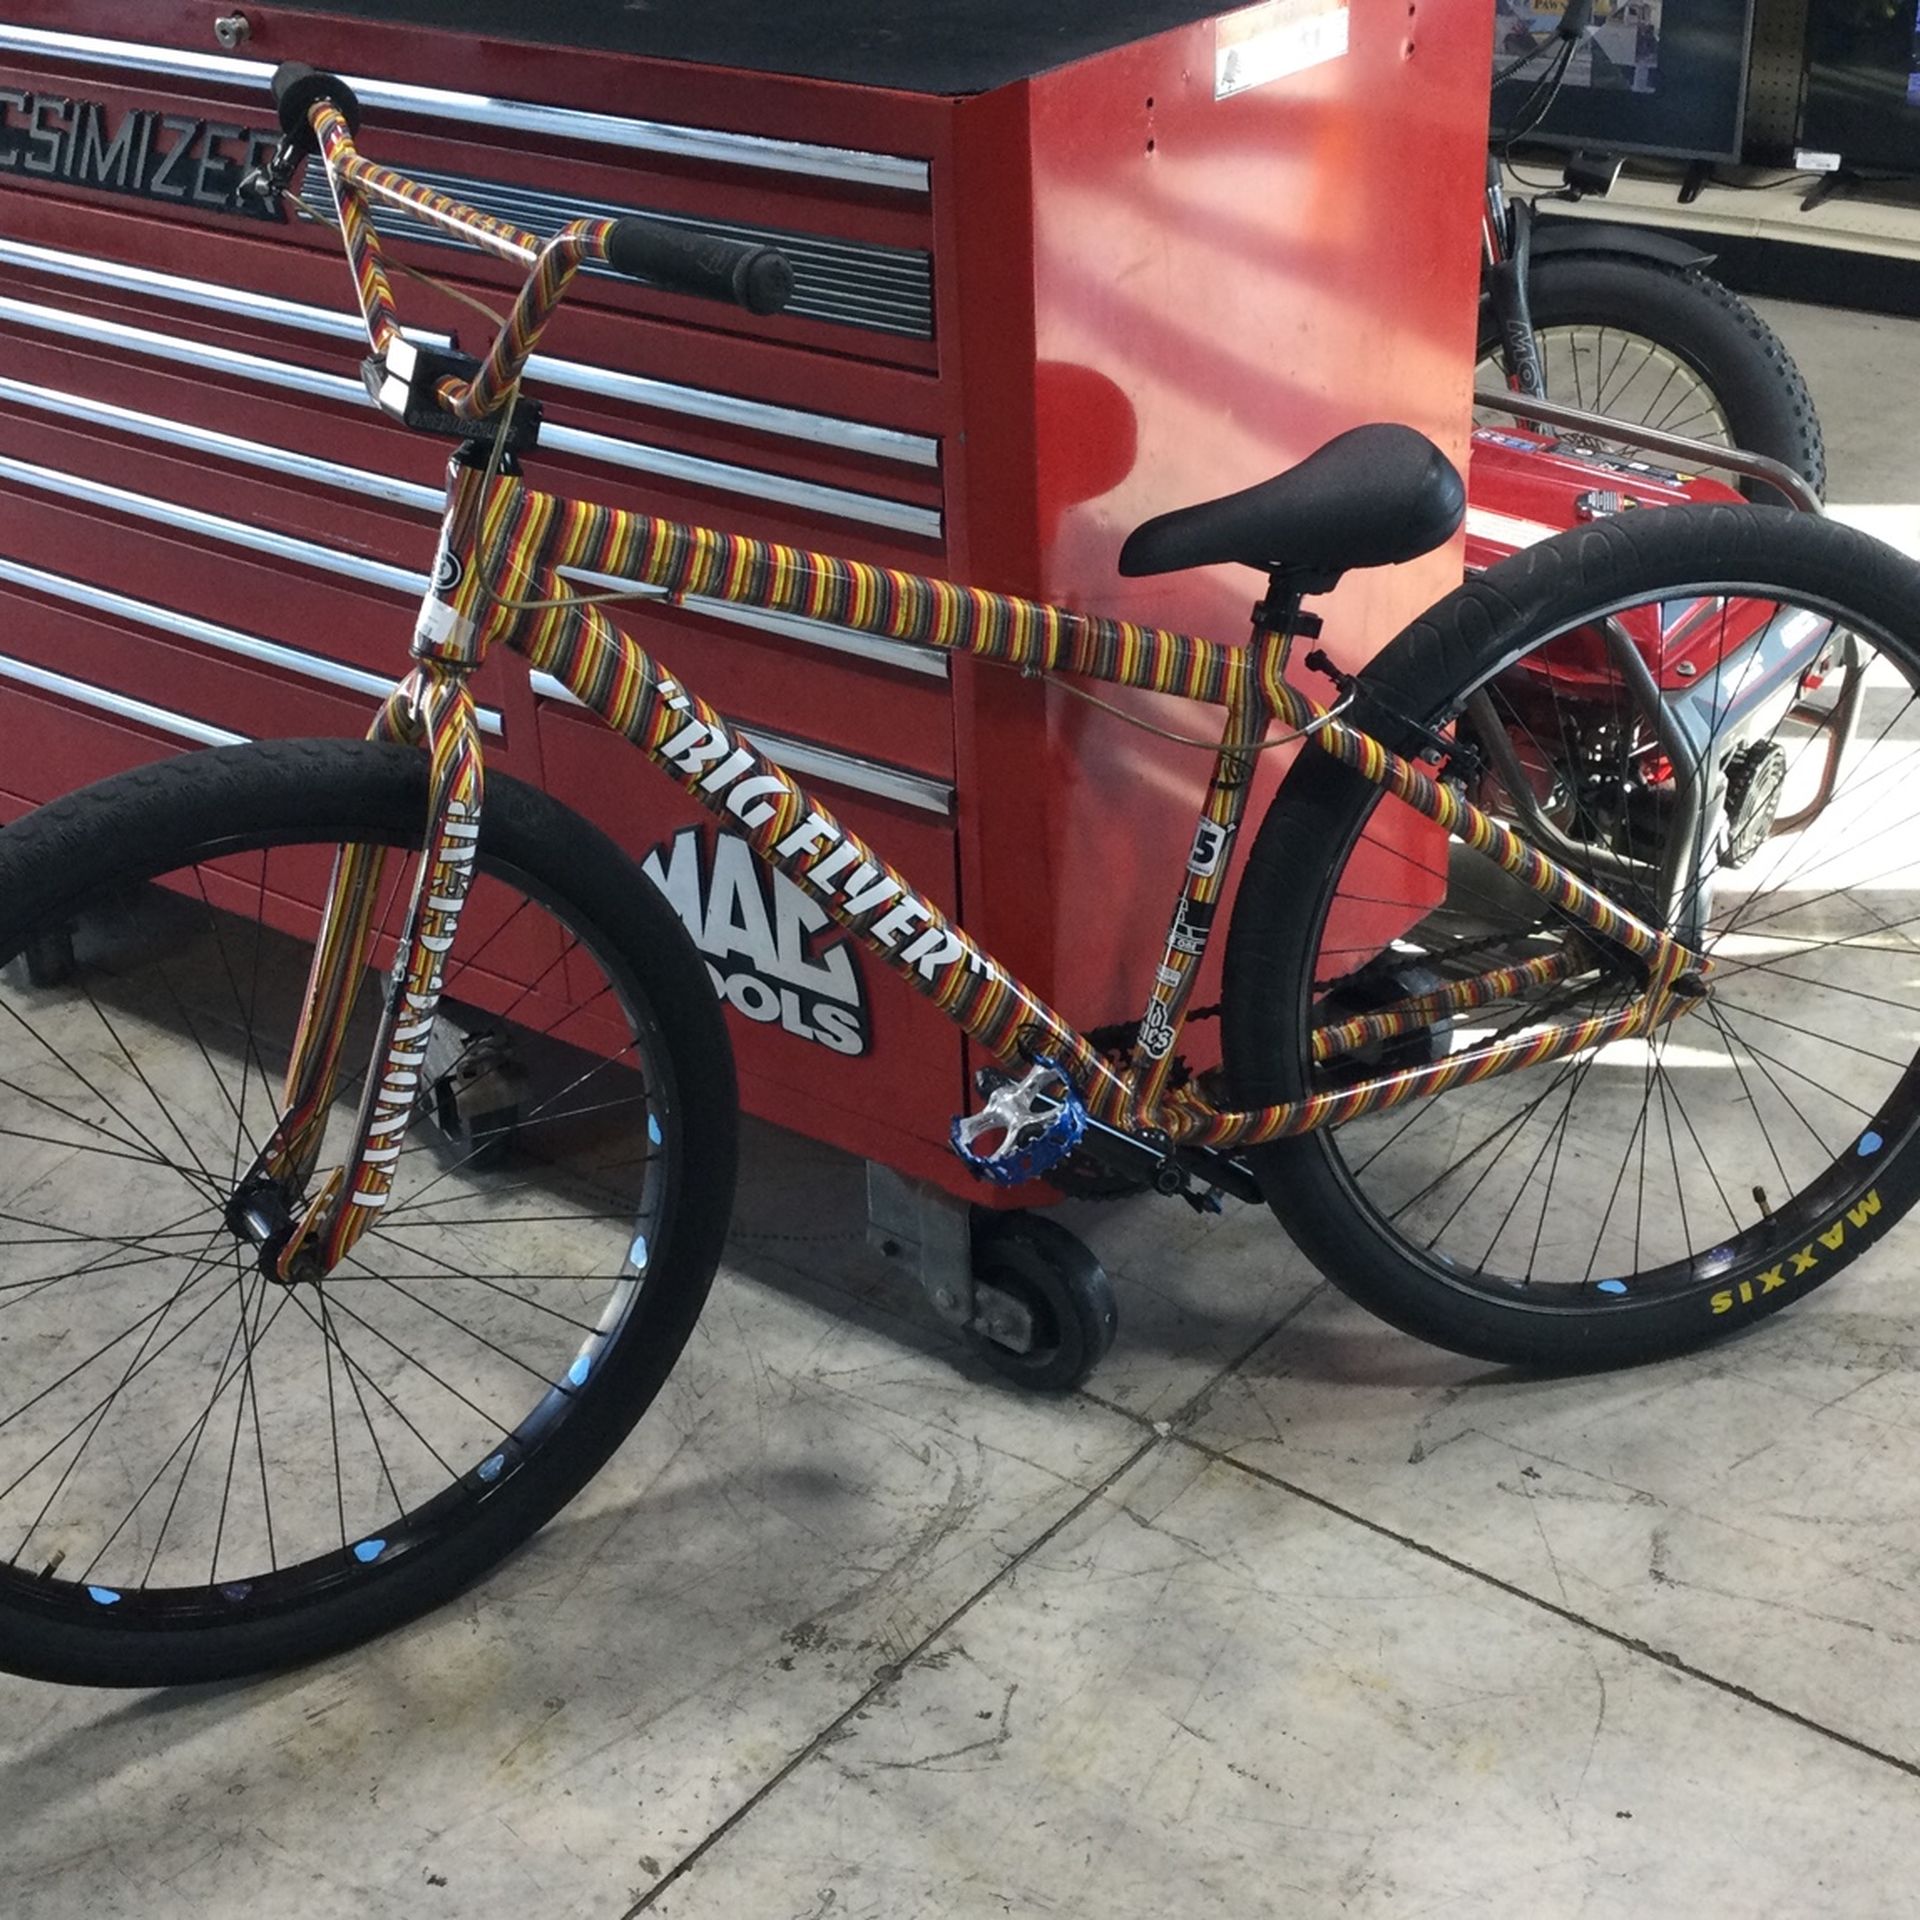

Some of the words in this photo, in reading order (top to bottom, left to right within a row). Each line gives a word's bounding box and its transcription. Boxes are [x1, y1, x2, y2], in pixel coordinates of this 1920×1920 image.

[641, 829, 860, 1007] MAC
[704, 960, 863, 1056] OLS
[1710, 1188, 1883, 1315] MAXXIS
